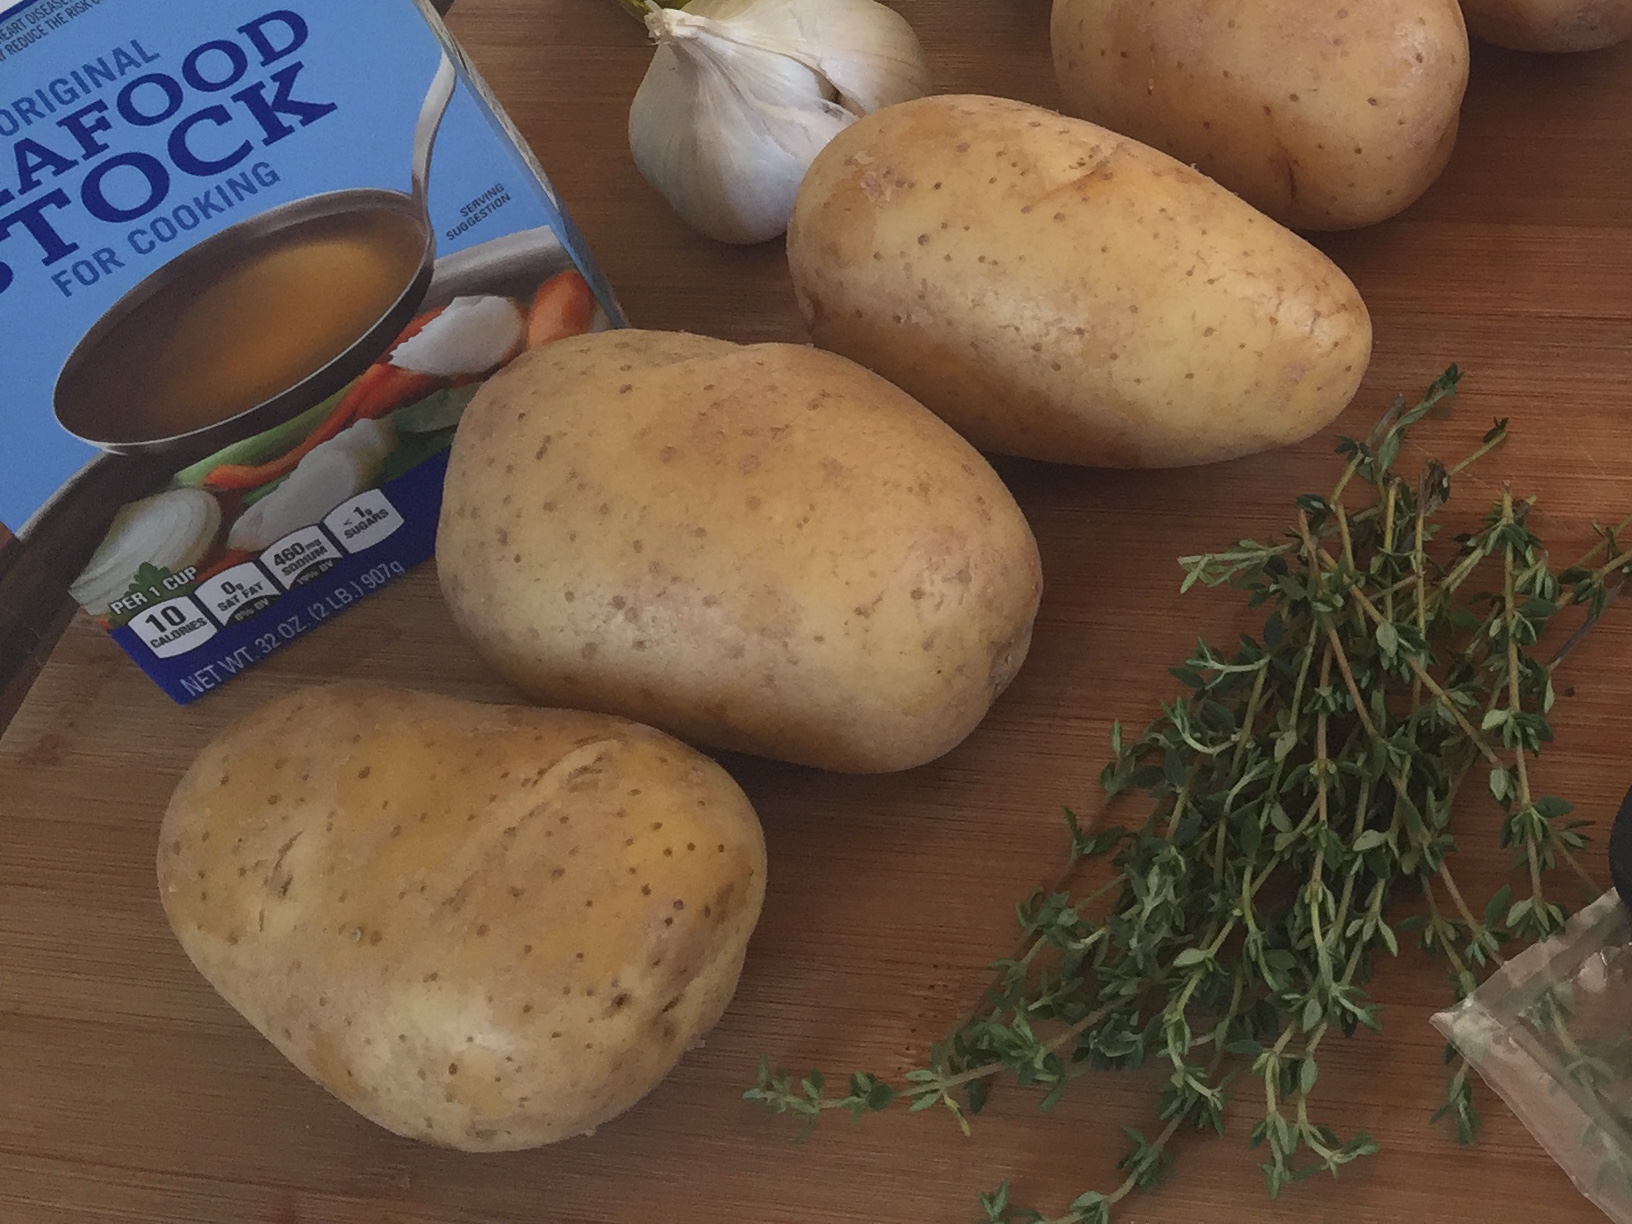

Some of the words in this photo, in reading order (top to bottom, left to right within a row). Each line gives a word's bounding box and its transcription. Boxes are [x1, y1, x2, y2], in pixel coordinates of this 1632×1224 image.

[5, 24, 48, 55] REDUCE
[44, 13, 69, 31] THE
[0, 39, 161, 137] ORIGINAL
[0, 9, 309, 207] AFOOD
[0, 61, 338, 294] TOCK
[460, 182, 505, 217] SERVING
[51, 247, 126, 297] FOR
[127, 161, 281, 255] COOKING
[446, 192, 511, 241] SUGGESTION
[343, 508, 389, 539] SUGARS
[281, 545, 328, 576] SODIUM
[110, 591, 148, 615] PER
[149, 586, 161, 597] 1
[162, 565, 198, 591] CUP
[217, 594, 241, 612] SAT
[242, 581, 265, 599] FAT
[145, 605, 187, 633] 10
[150, 617, 208, 649] CALORIES
[179, 664, 222, 697] NET
[217, 646, 260, 675] WT.
[254, 633, 280, 654] 32
[277, 615, 312, 639] OZ.
[307, 602, 330, 622] (2
[360, 560, 406, 590] 907g
